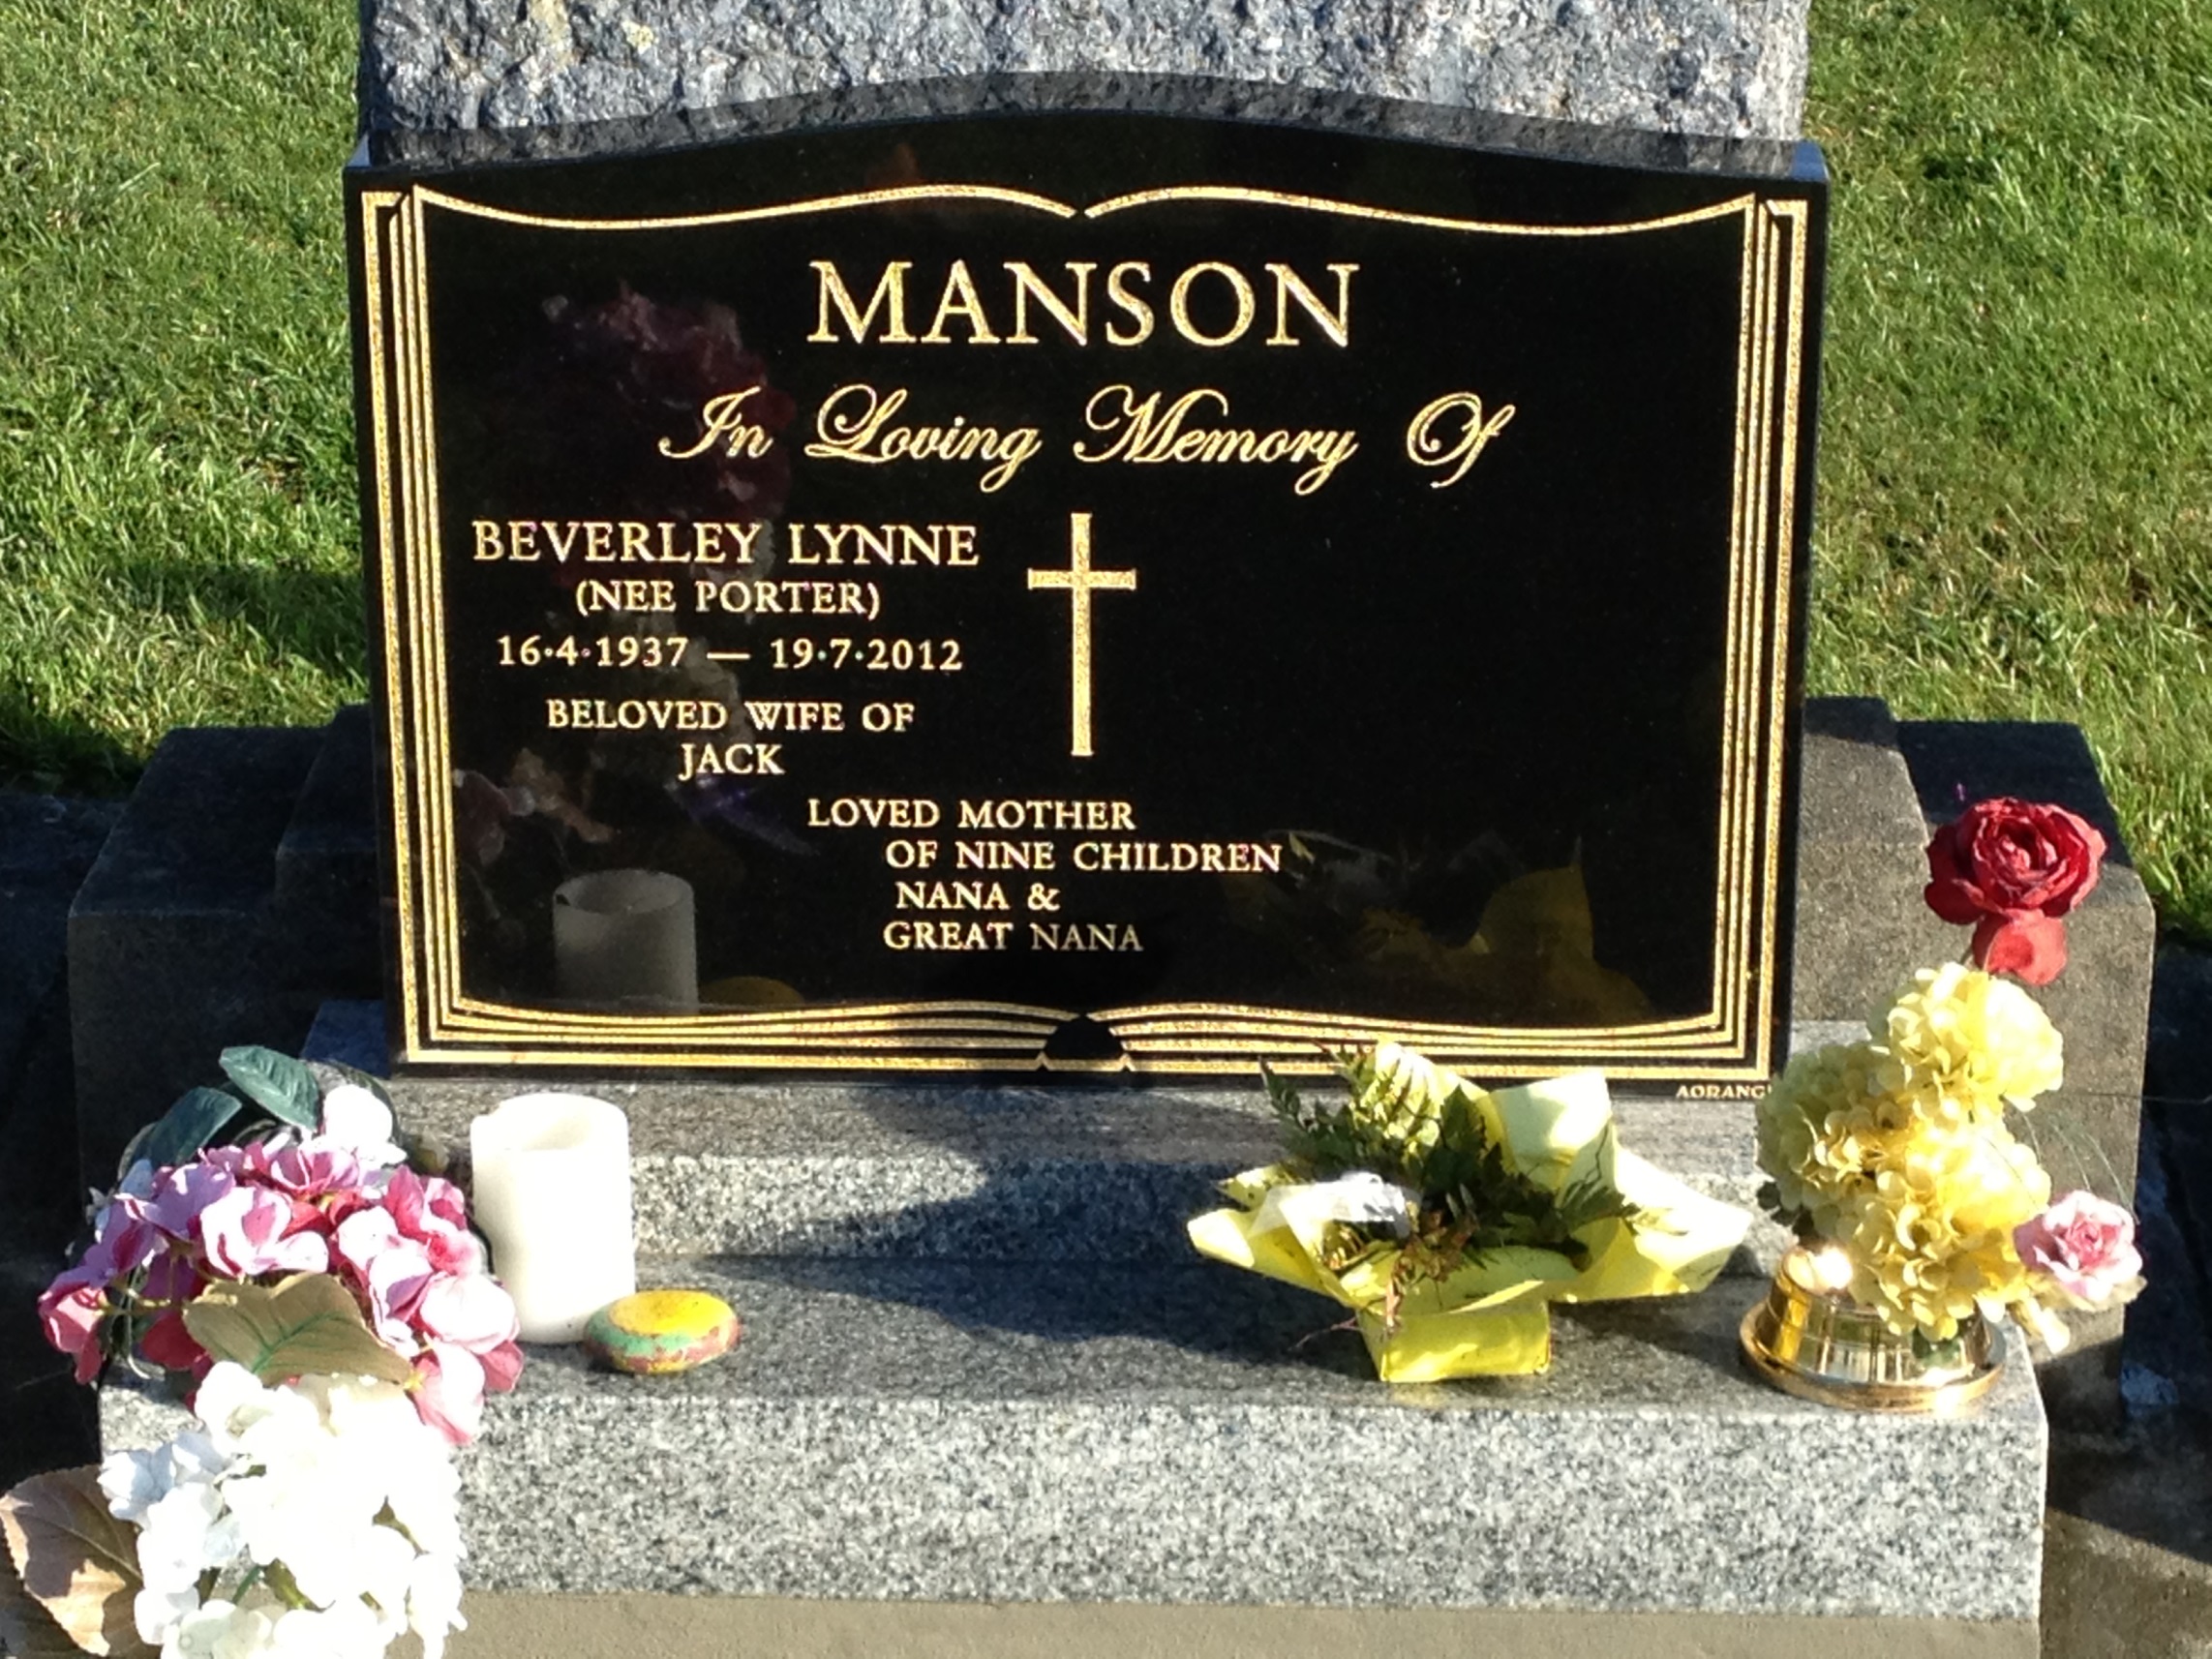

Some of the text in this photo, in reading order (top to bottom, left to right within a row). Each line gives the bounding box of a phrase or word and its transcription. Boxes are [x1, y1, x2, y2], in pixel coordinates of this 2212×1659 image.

[807, 260, 1359, 347] MANSON
[658, 384, 1515, 495] In Loving Memory Of
[472, 521, 979, 565] BEVERLEY LYNNE
[576, 580, 879, 620] (NEE PORTER)
[547, 699, 914, 732] BELOVED WIFE OF
[679, 743, 784, 780] JACK
[808, 799, 1136, 830] LOVED MOTHER
[886, 840, 1282, 872] OF NINE CHILDREN
[896, 882, 1060, 911] NANA &
[884, 921, 1139, 950] GREAT NANA
